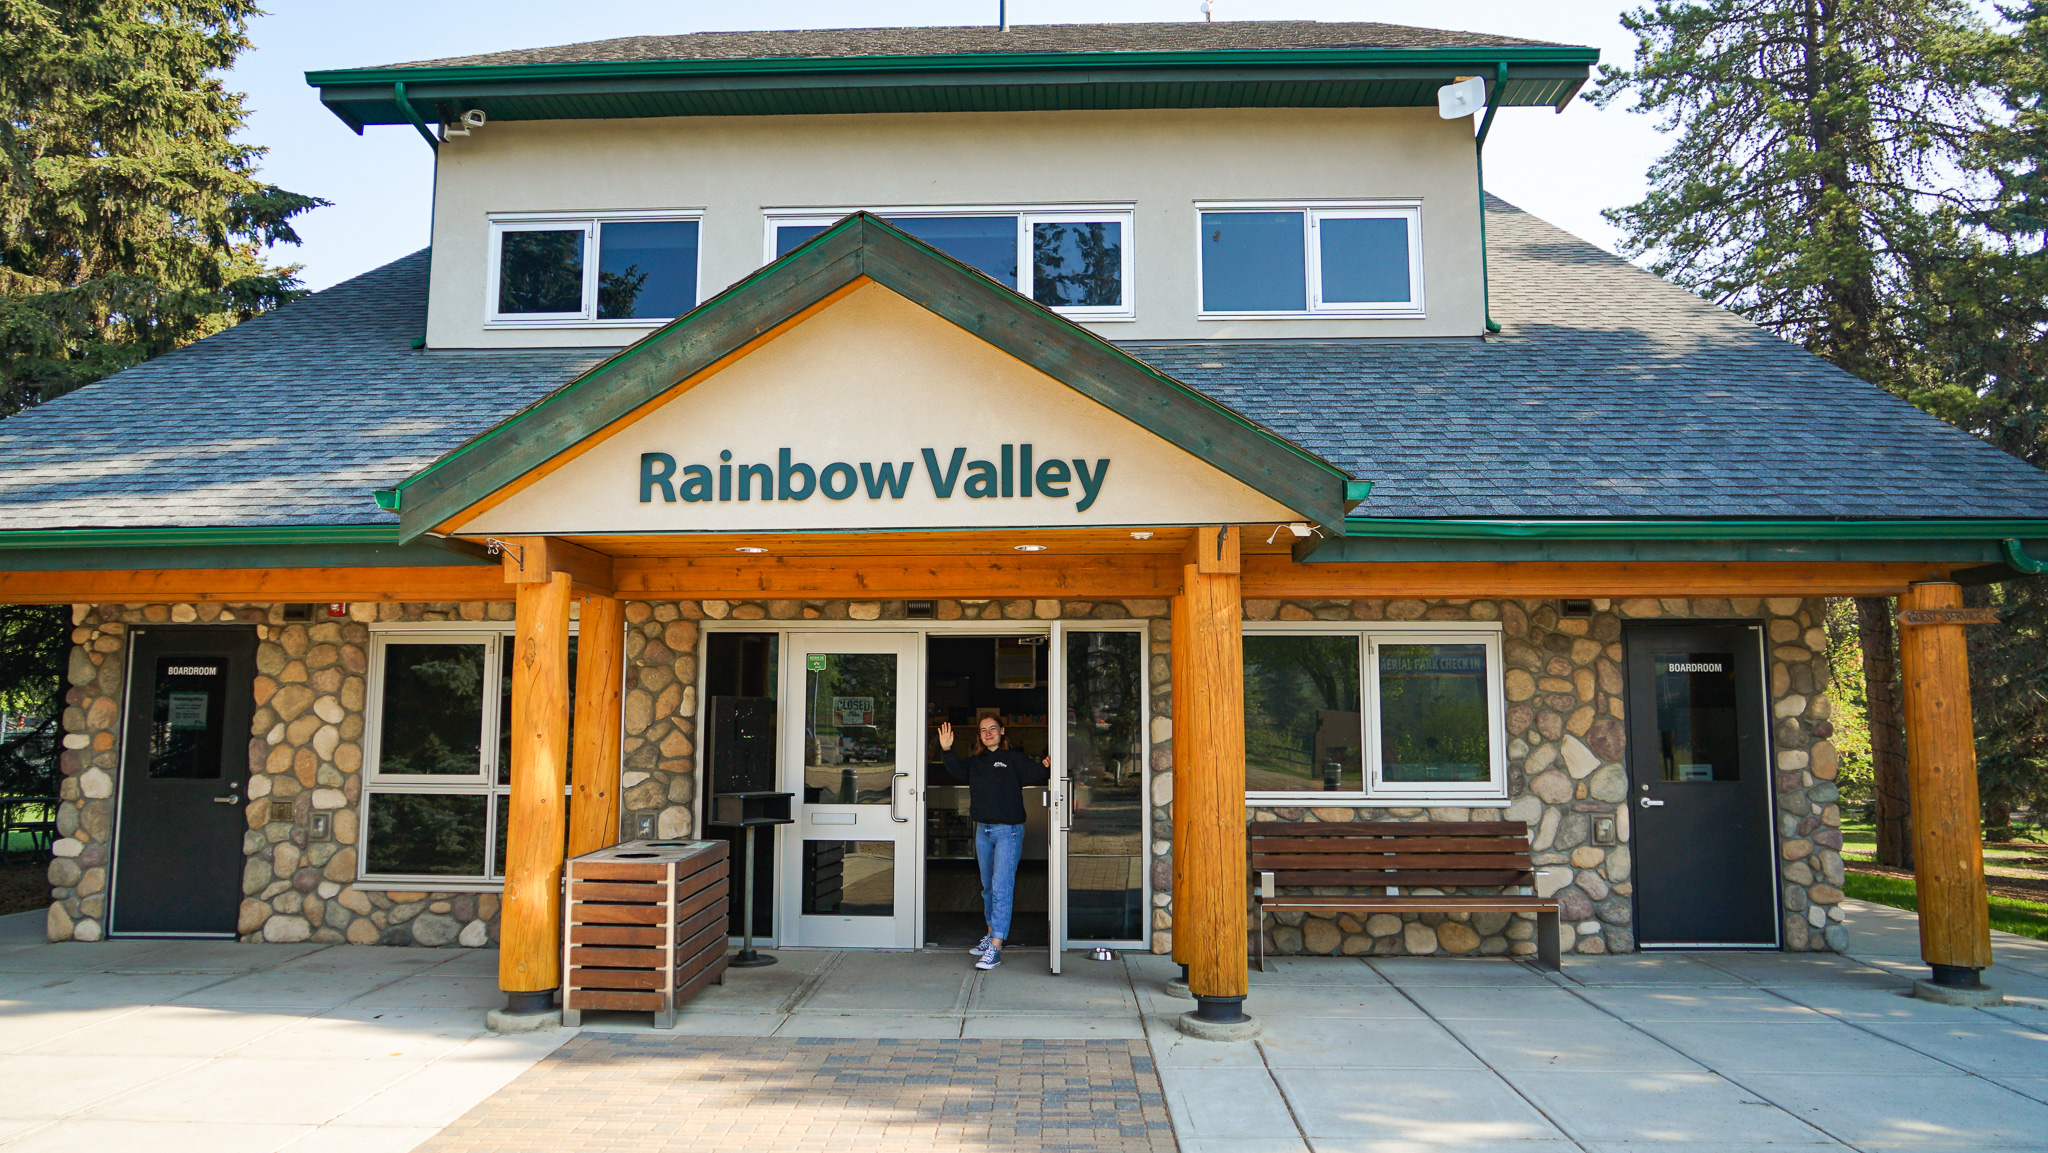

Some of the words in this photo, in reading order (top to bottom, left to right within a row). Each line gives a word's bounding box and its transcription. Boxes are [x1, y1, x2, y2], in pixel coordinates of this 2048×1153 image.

[640, 447, 914, 503] Rainbow
[920, 443, 1111, 513] Valley
[1380, 658, 1413, 671] AERIAL
[1414, 658, 1439, 671] PARK
[1440, 658, 1469, 671] CHECK
[1470, 657, 1481, 671] IN
[1668, 663, 1723, 673] BOARDROOM
[167, 666, 217, 676] BOARDROOM
[835, 700, 871, 712] CLOSED
